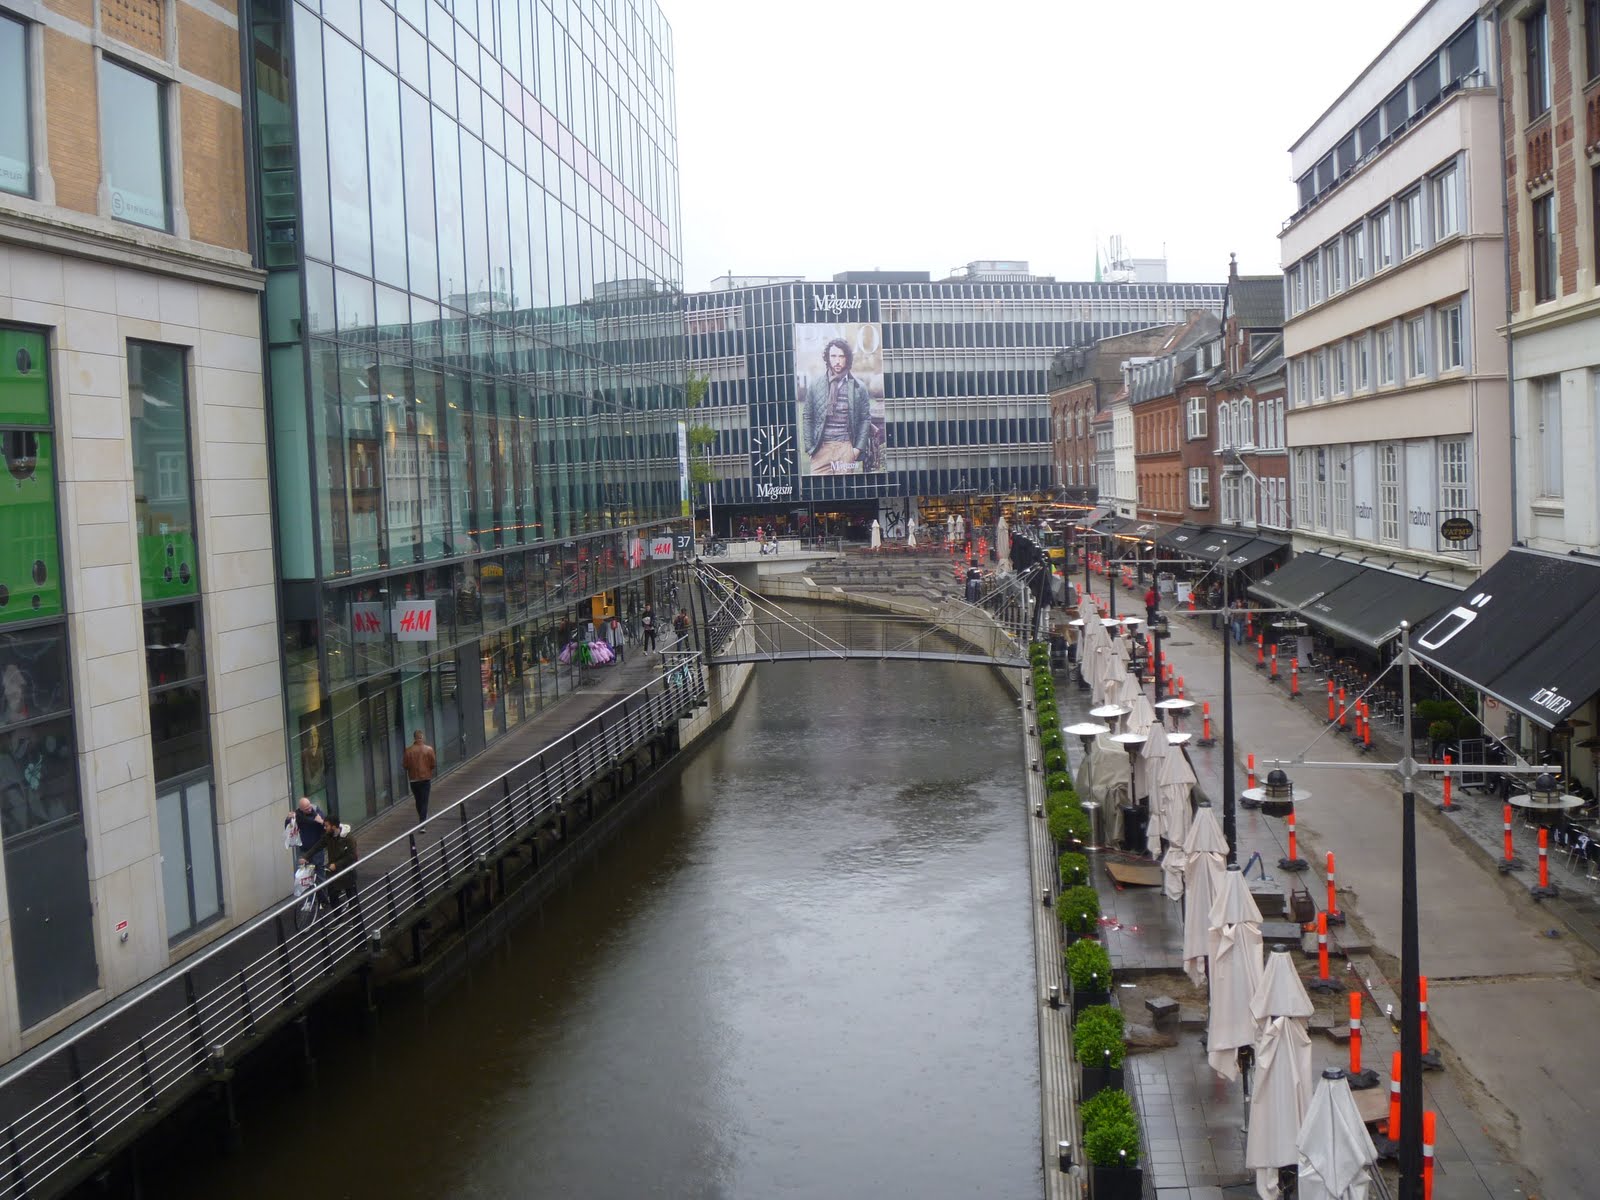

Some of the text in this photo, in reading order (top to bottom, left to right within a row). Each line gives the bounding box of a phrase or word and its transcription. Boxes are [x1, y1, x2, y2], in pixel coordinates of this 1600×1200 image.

[812, 293, 863, 315] Magasin
[756, 483, 793, 500] Magasin
[654, 543, 671, 555] H&M
[677, 535, 691, 548] 37
[400, 609, 432, 632] H&M
